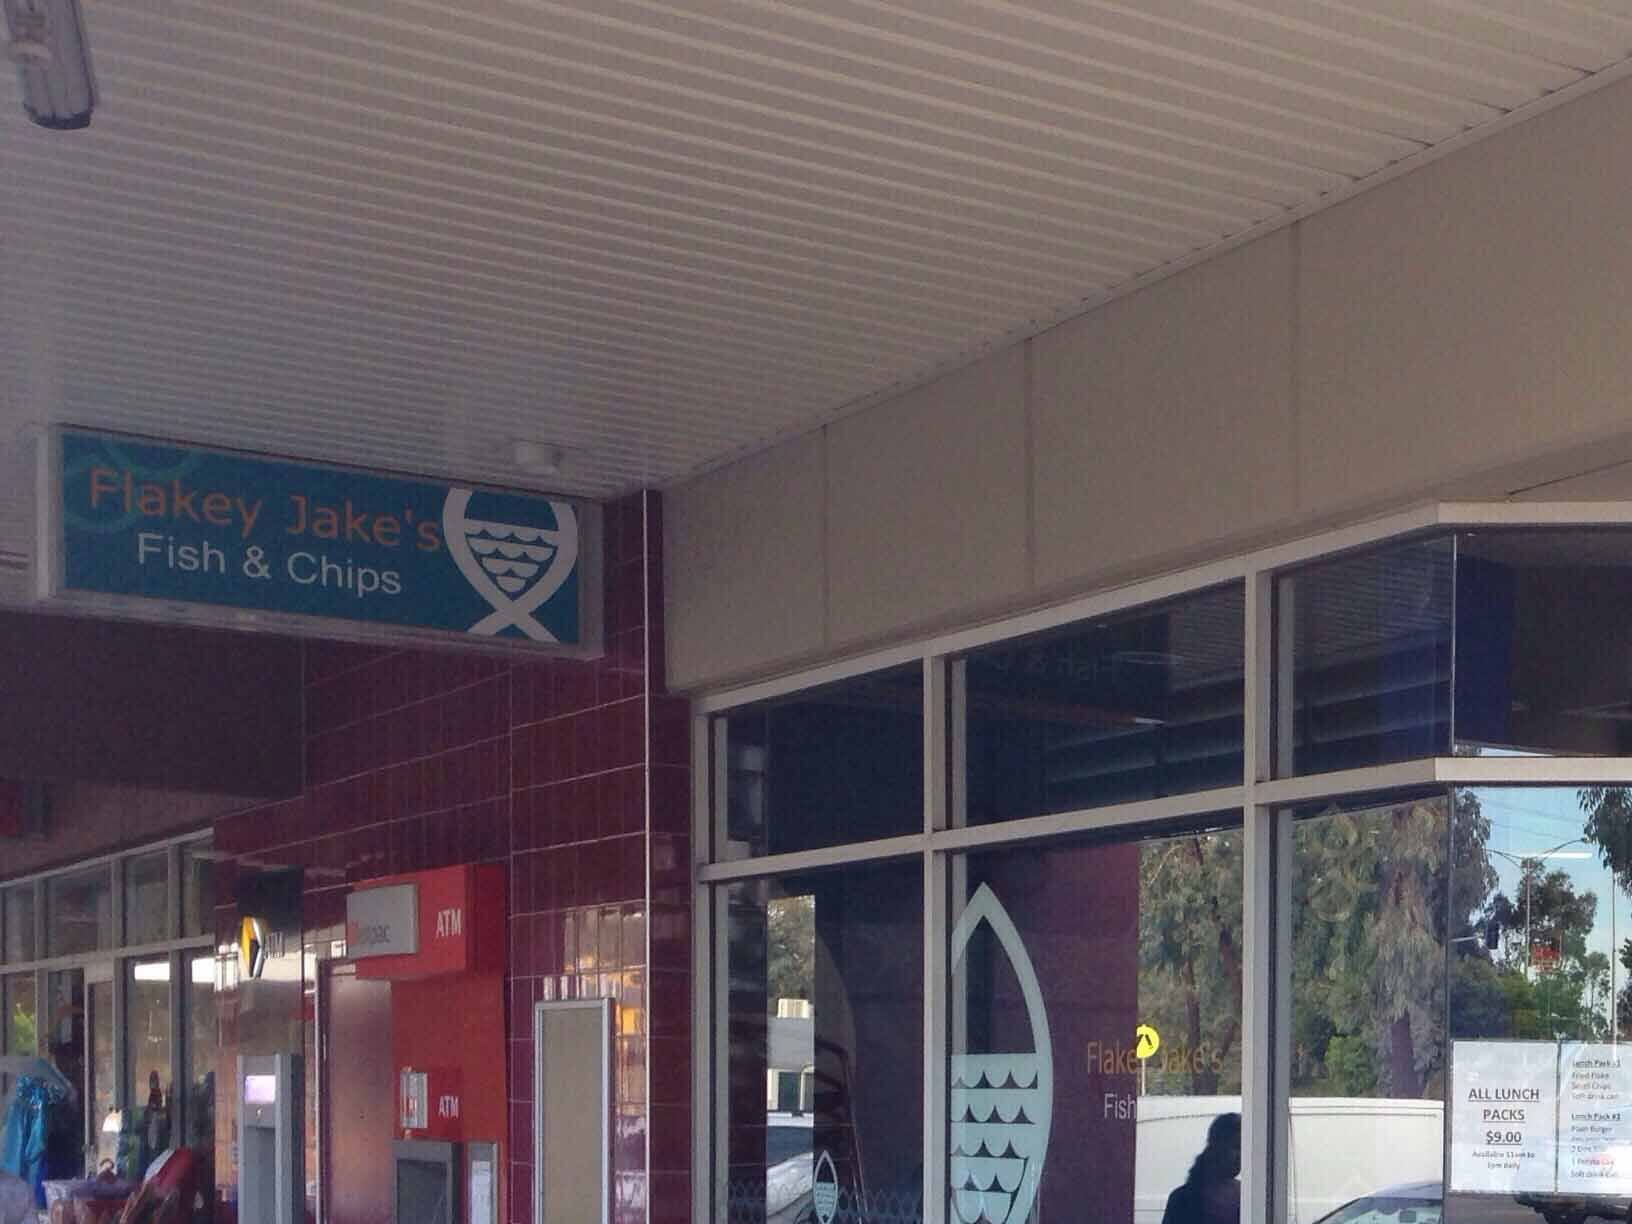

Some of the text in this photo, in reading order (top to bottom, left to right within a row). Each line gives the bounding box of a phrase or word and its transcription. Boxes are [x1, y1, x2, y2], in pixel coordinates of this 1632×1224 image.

[90, 466, 441, 551] Flakey Jake's
[137, 532, 402, 598] Fish & Chips
[435, 908, 462, 939] ATM
[1087, 1041, 1146, 1075] Flake
[438, 1095, 460, 1119] ATM
[1104, 1093, 1137, 1120] Fish
[1468, 1088, 1540, 1102] ALL LUNCH
[1483, 1108, 1526, 1122] PACKS
[1486, 1130, 1522, 1146] $9.00
